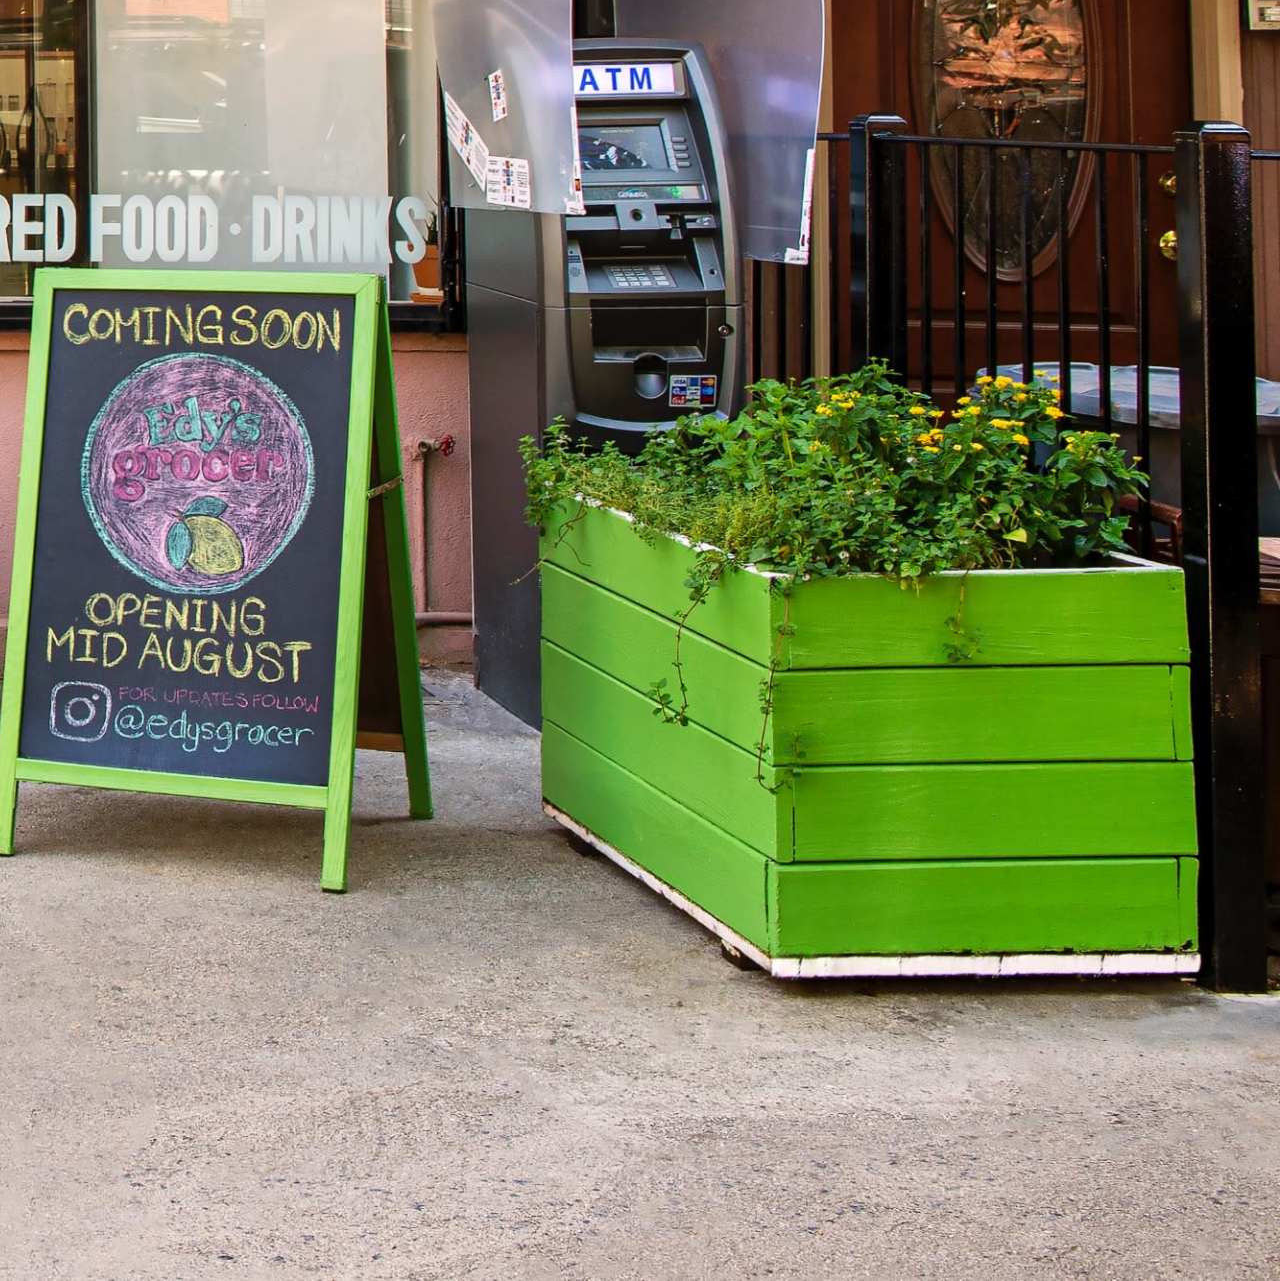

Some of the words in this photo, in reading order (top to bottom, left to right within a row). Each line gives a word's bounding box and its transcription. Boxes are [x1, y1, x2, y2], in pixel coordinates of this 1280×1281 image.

[578, 67, 654, 92] ATM
[90, 194, 220, 263] FOOD
[251, 194, 428, 264] DRINKS
[143, 397, 263, 452] Edy's
[111, 443, 285, 502] grocer
[85, 592, 267, 637] OPENING
[46, 626, 128, 668] MID
[137, 630, 313, 683] AUGUST
[118, 686, 157, 703] FOR
[163, 688, 249, 708] UPDATES
[252, 693, 320, 713] FOLLOW
[114, 704, 315, 753] @edysgrocer
